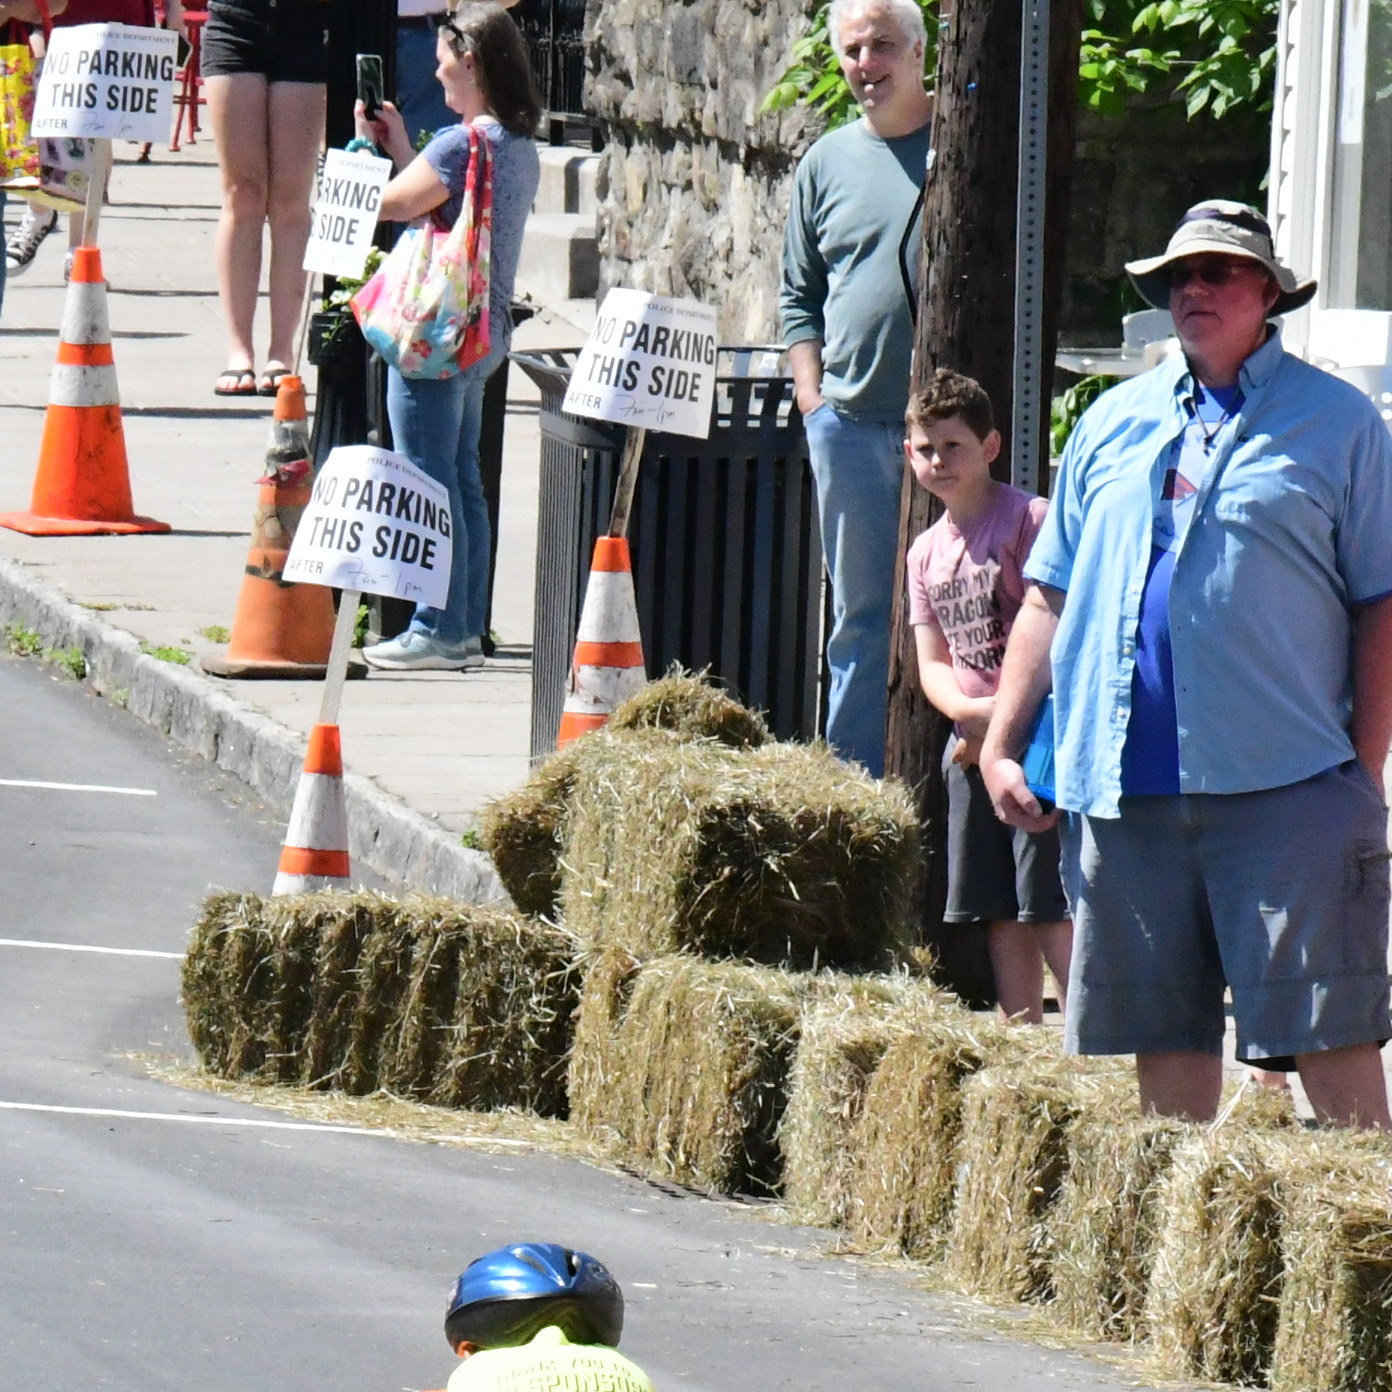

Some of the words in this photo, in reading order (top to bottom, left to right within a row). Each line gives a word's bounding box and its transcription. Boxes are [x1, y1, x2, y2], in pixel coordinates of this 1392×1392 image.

[44, 51, 70, 75] NO
[77, 50, 174, 82] PARKING
[51, 83, 98, 109] THIS
[106, 84, 159, 114] SIDE
[34, 118, 68, 129] AFTER
[317, 177, 381, 213] RKING
[318, 213, 360, 246] SIDE
[590, 316, 616, 345] NO
[618, 319, 715, 366] PARKING
[587, 353, 641, 392] THIS
[647, 365, 702, 403] SIDE
[568, 391, 603, 410] AFTER
[366, 456, 400, 471] POLICE
[312, 476, 338, 507] NO
[341, 477, 451, 539] PARKING
[309, 516, 364, 554] THIS
[371, 525, 437, 571] SIDE
[289, 558, 324, 575] AFTER
[927, 577, 970, 603] SORRY
[972, 568, 991, 591] MY
[936, 589, 1002, 630] RAGON
[964, 620, 1007, 648] YOUR
[571, 1357, 604, 1370] YOU
